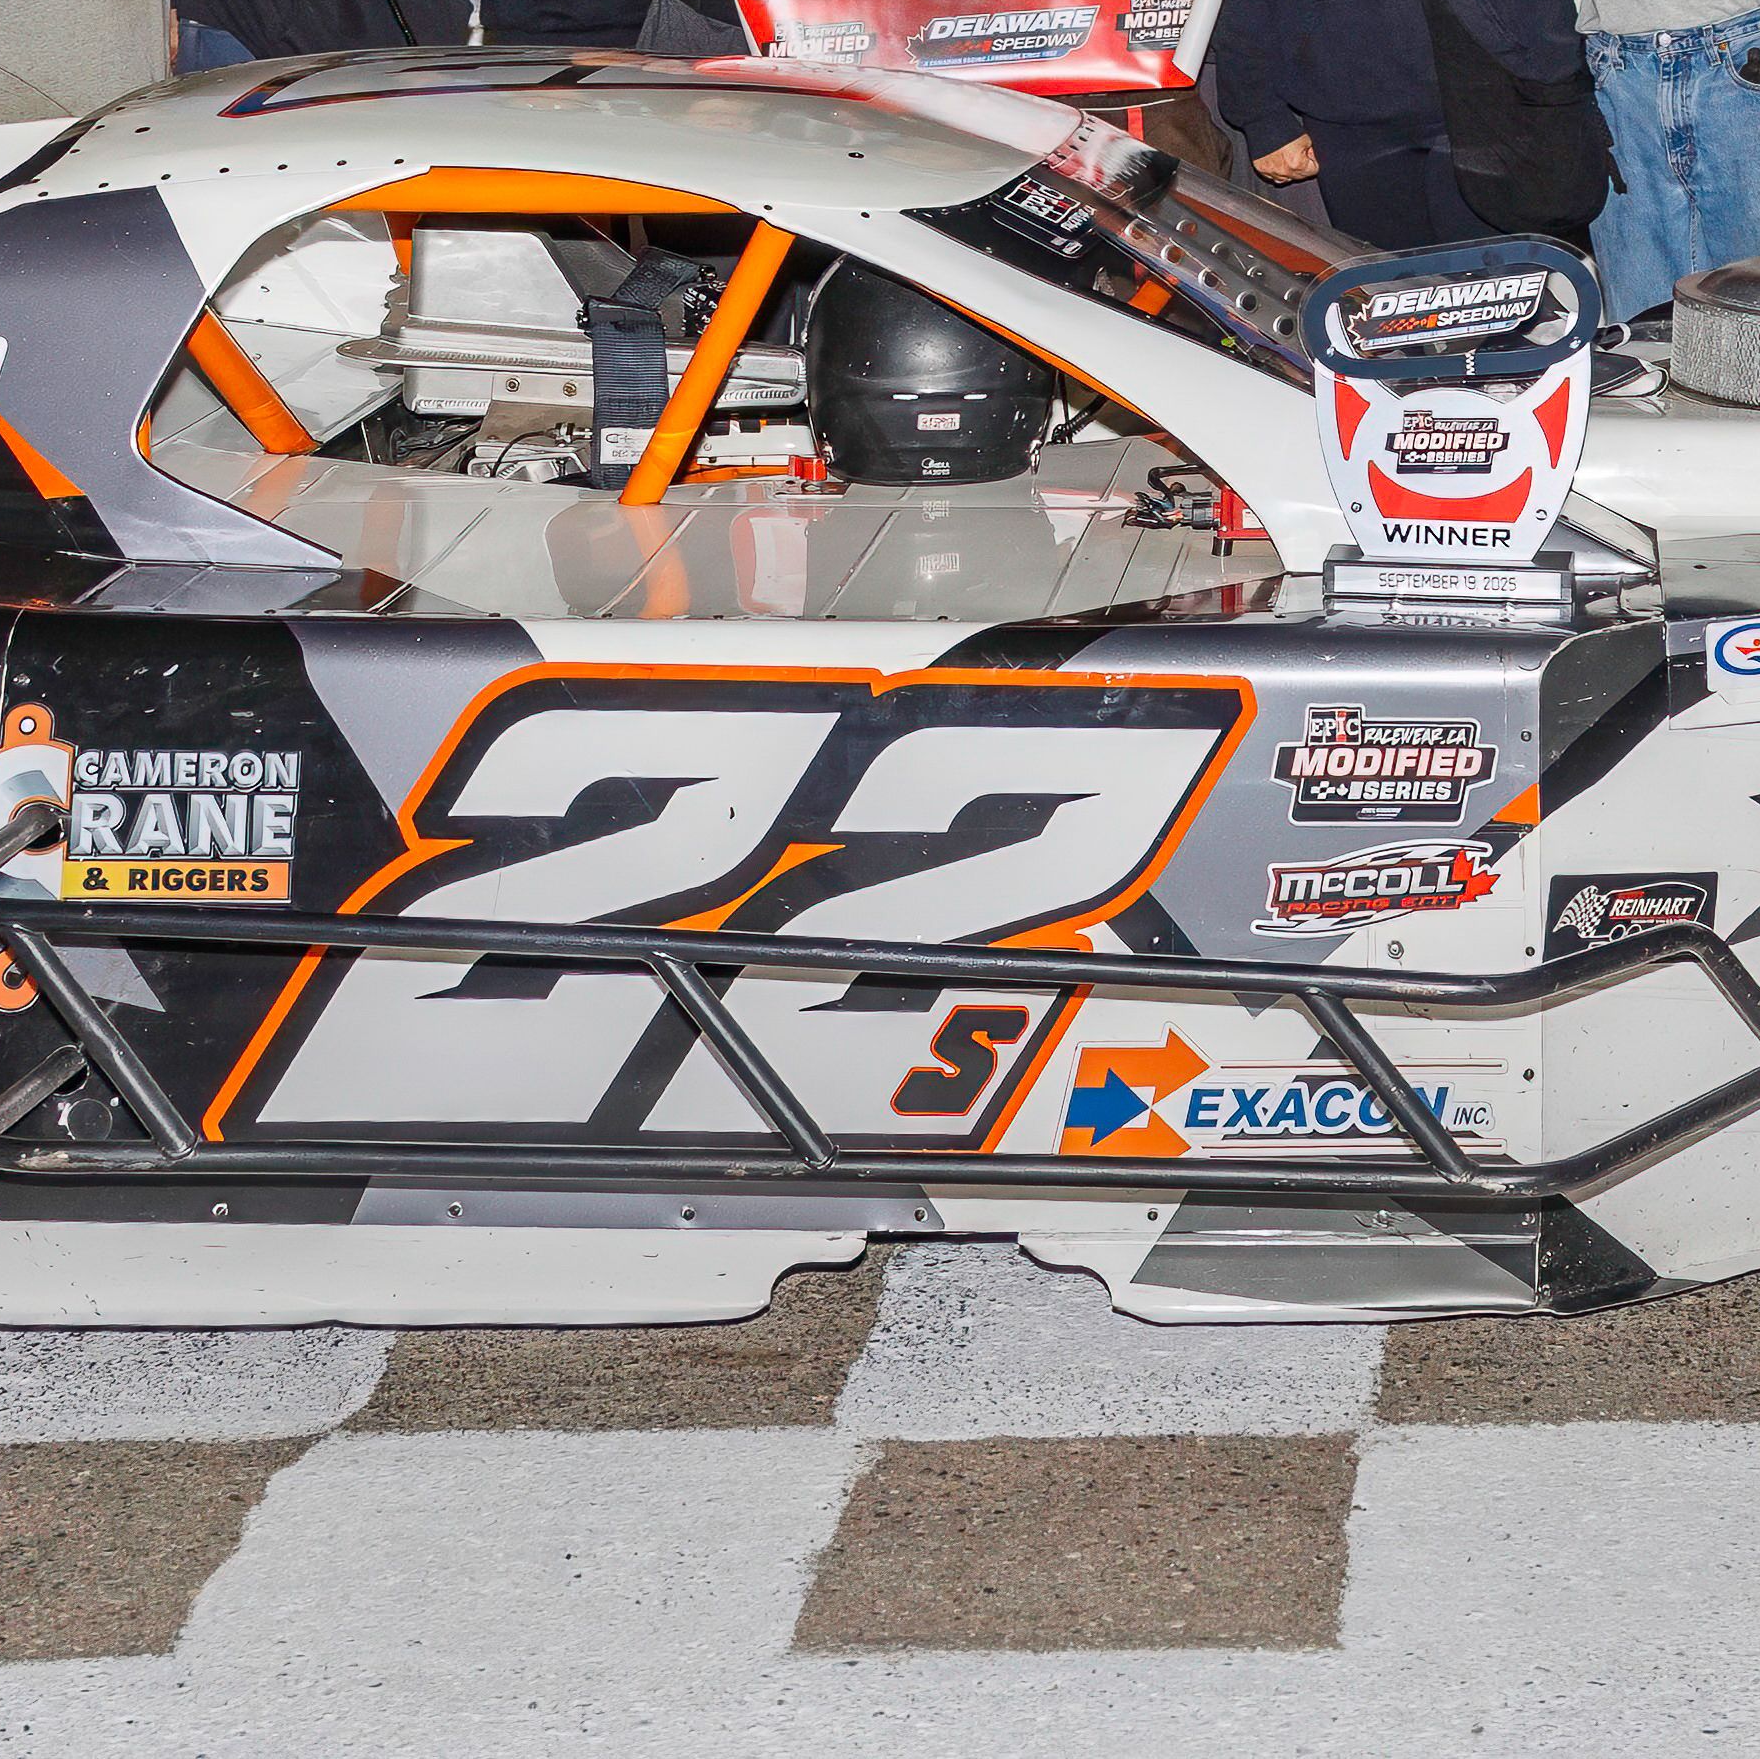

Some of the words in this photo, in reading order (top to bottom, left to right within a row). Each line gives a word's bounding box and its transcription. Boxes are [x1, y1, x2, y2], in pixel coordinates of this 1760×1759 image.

[928, 7, 1098, 40] DELAWARE
[1124, 12, 1188, 30] MODIF
[992, 31, 1084, 52] SPEEDWAY
[1369, 275, 1543, 318] DELAWARE
[1436, 300, 1533, 327] SPEEDWAY
[1393, 432, 1504, 450] MODIFIED
[1382, 523, 1512, 548] WINNER
[1378, 571, 1461, 591] SEPTEMBER
[1483, 575, 1518, 592] 2025
[1310, 711, 1361, 742] EPIC
[1364, 726, 1468, 746] RACEWEAR.CA
[74, 749, 300, 792] CAMERON
[1291, 747, 1483, 778] MODIFIED
[1364, 781, 1452, 800] SERIES
[82, 867, 110, 892] &
[128, 867, 269, 892] RIGGERS
[1609, 896, 1696, 917] REINHART
[255, 710, 1225, 1134] 22
[891, 1005, 1029, 1117] S
[1452, 1106, 1491, 1126] INC.
